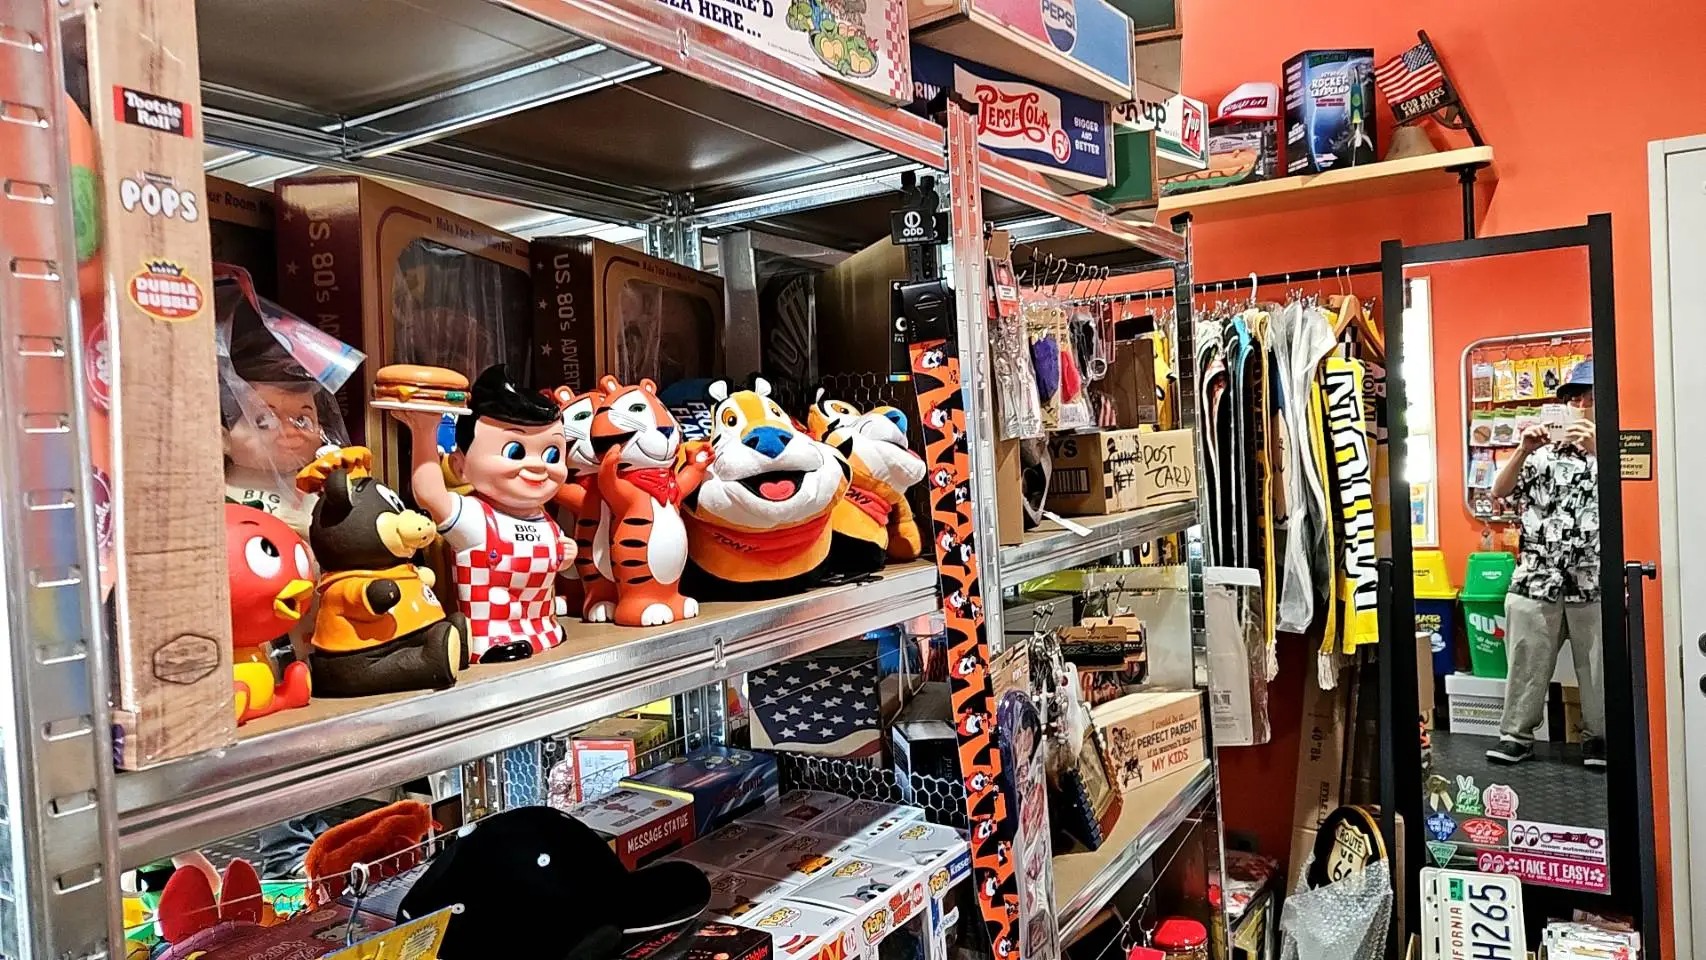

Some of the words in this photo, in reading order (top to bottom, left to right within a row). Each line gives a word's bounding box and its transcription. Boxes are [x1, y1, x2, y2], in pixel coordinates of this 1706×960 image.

[1042, 0, 1076, 30] PEPSI
[124, 90, 182, 118] Tootsie
[1400, 98, 1418, 111] GOD
[1420, 87, 1446, 102] BLESS
[1405, 98, 1441, 118] AMERICA
[137, 109, 171, 130] Roll
[1074, 116, 1099, 132] BIGGER
[1075, 139, 1100, 154] BETTER
[1081, 132, 1093, 140] AND
[119, 177, 199, 223] POPS
[902, 227, 924, 237] ODD
[136, 277, 197, 298] DUBBLE
[311, 252, 339, 303] 80's
[137, 291, 199, 311] BUBBLE
[556, 292, 577, 331] 80's
[1143, 445, 1177, 469] POST
[1145, 465, 1191, 488] CARD
[244, 489, 281, 504] BIG
[514, 524, 537, 532] BIG
[515, 533, 541, 541] BOY
[712, 532, 762, 553] TONY
[1137, 729, 1169, 749] PERFECT
[1170, 719, 1198, 739] PARENT
[1152, 756, 1166, 773] MY
[1168, 748, 1189, 766] KIDS
[627, 825, 662, 854] MESSAGE
[663, 811, 690, 838] STATUE
[1340, 829, 1363, 853] ROUTE
[1519, 859, 1546, 875] TAKE
[1549, 862, 1559, 877] IT
[1562, 864, 1591, 884] EASY
[861, 909, 887, 940] POP!
